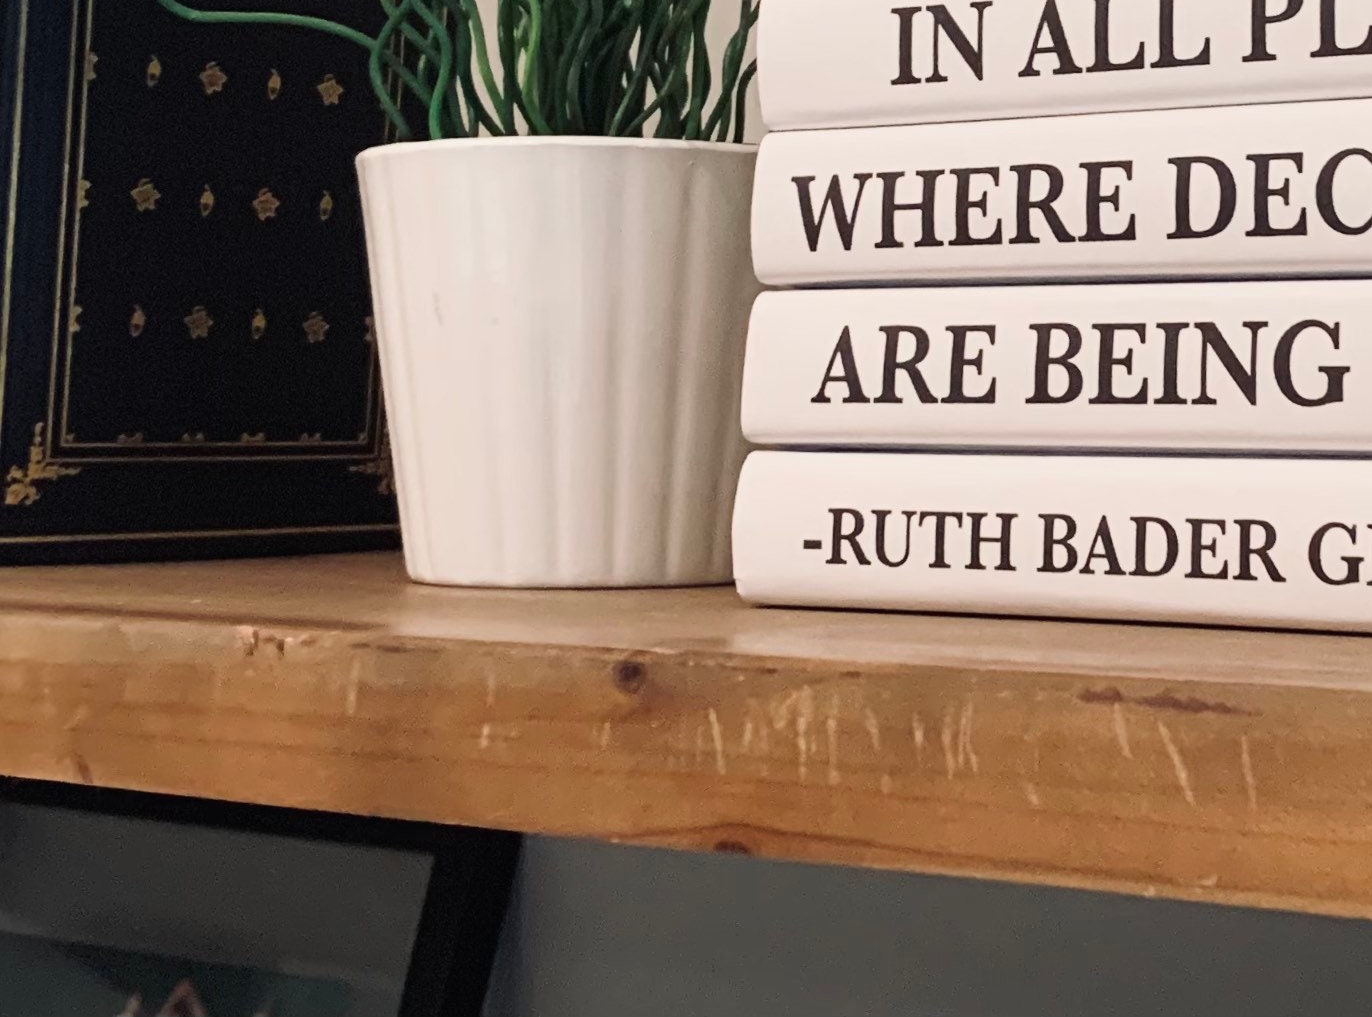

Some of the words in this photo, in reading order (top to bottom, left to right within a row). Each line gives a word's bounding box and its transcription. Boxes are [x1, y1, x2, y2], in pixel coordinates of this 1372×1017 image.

[889, 0, 994, 87] IN
[790, 159, 1138, 253] WHERE
[809, 323, 998, 405] ARE
[1024, 318, 1352, 409] BEING
[802, 507, 1019, 573] -RUTH
[1035, 512, 1288, 584] BADER
